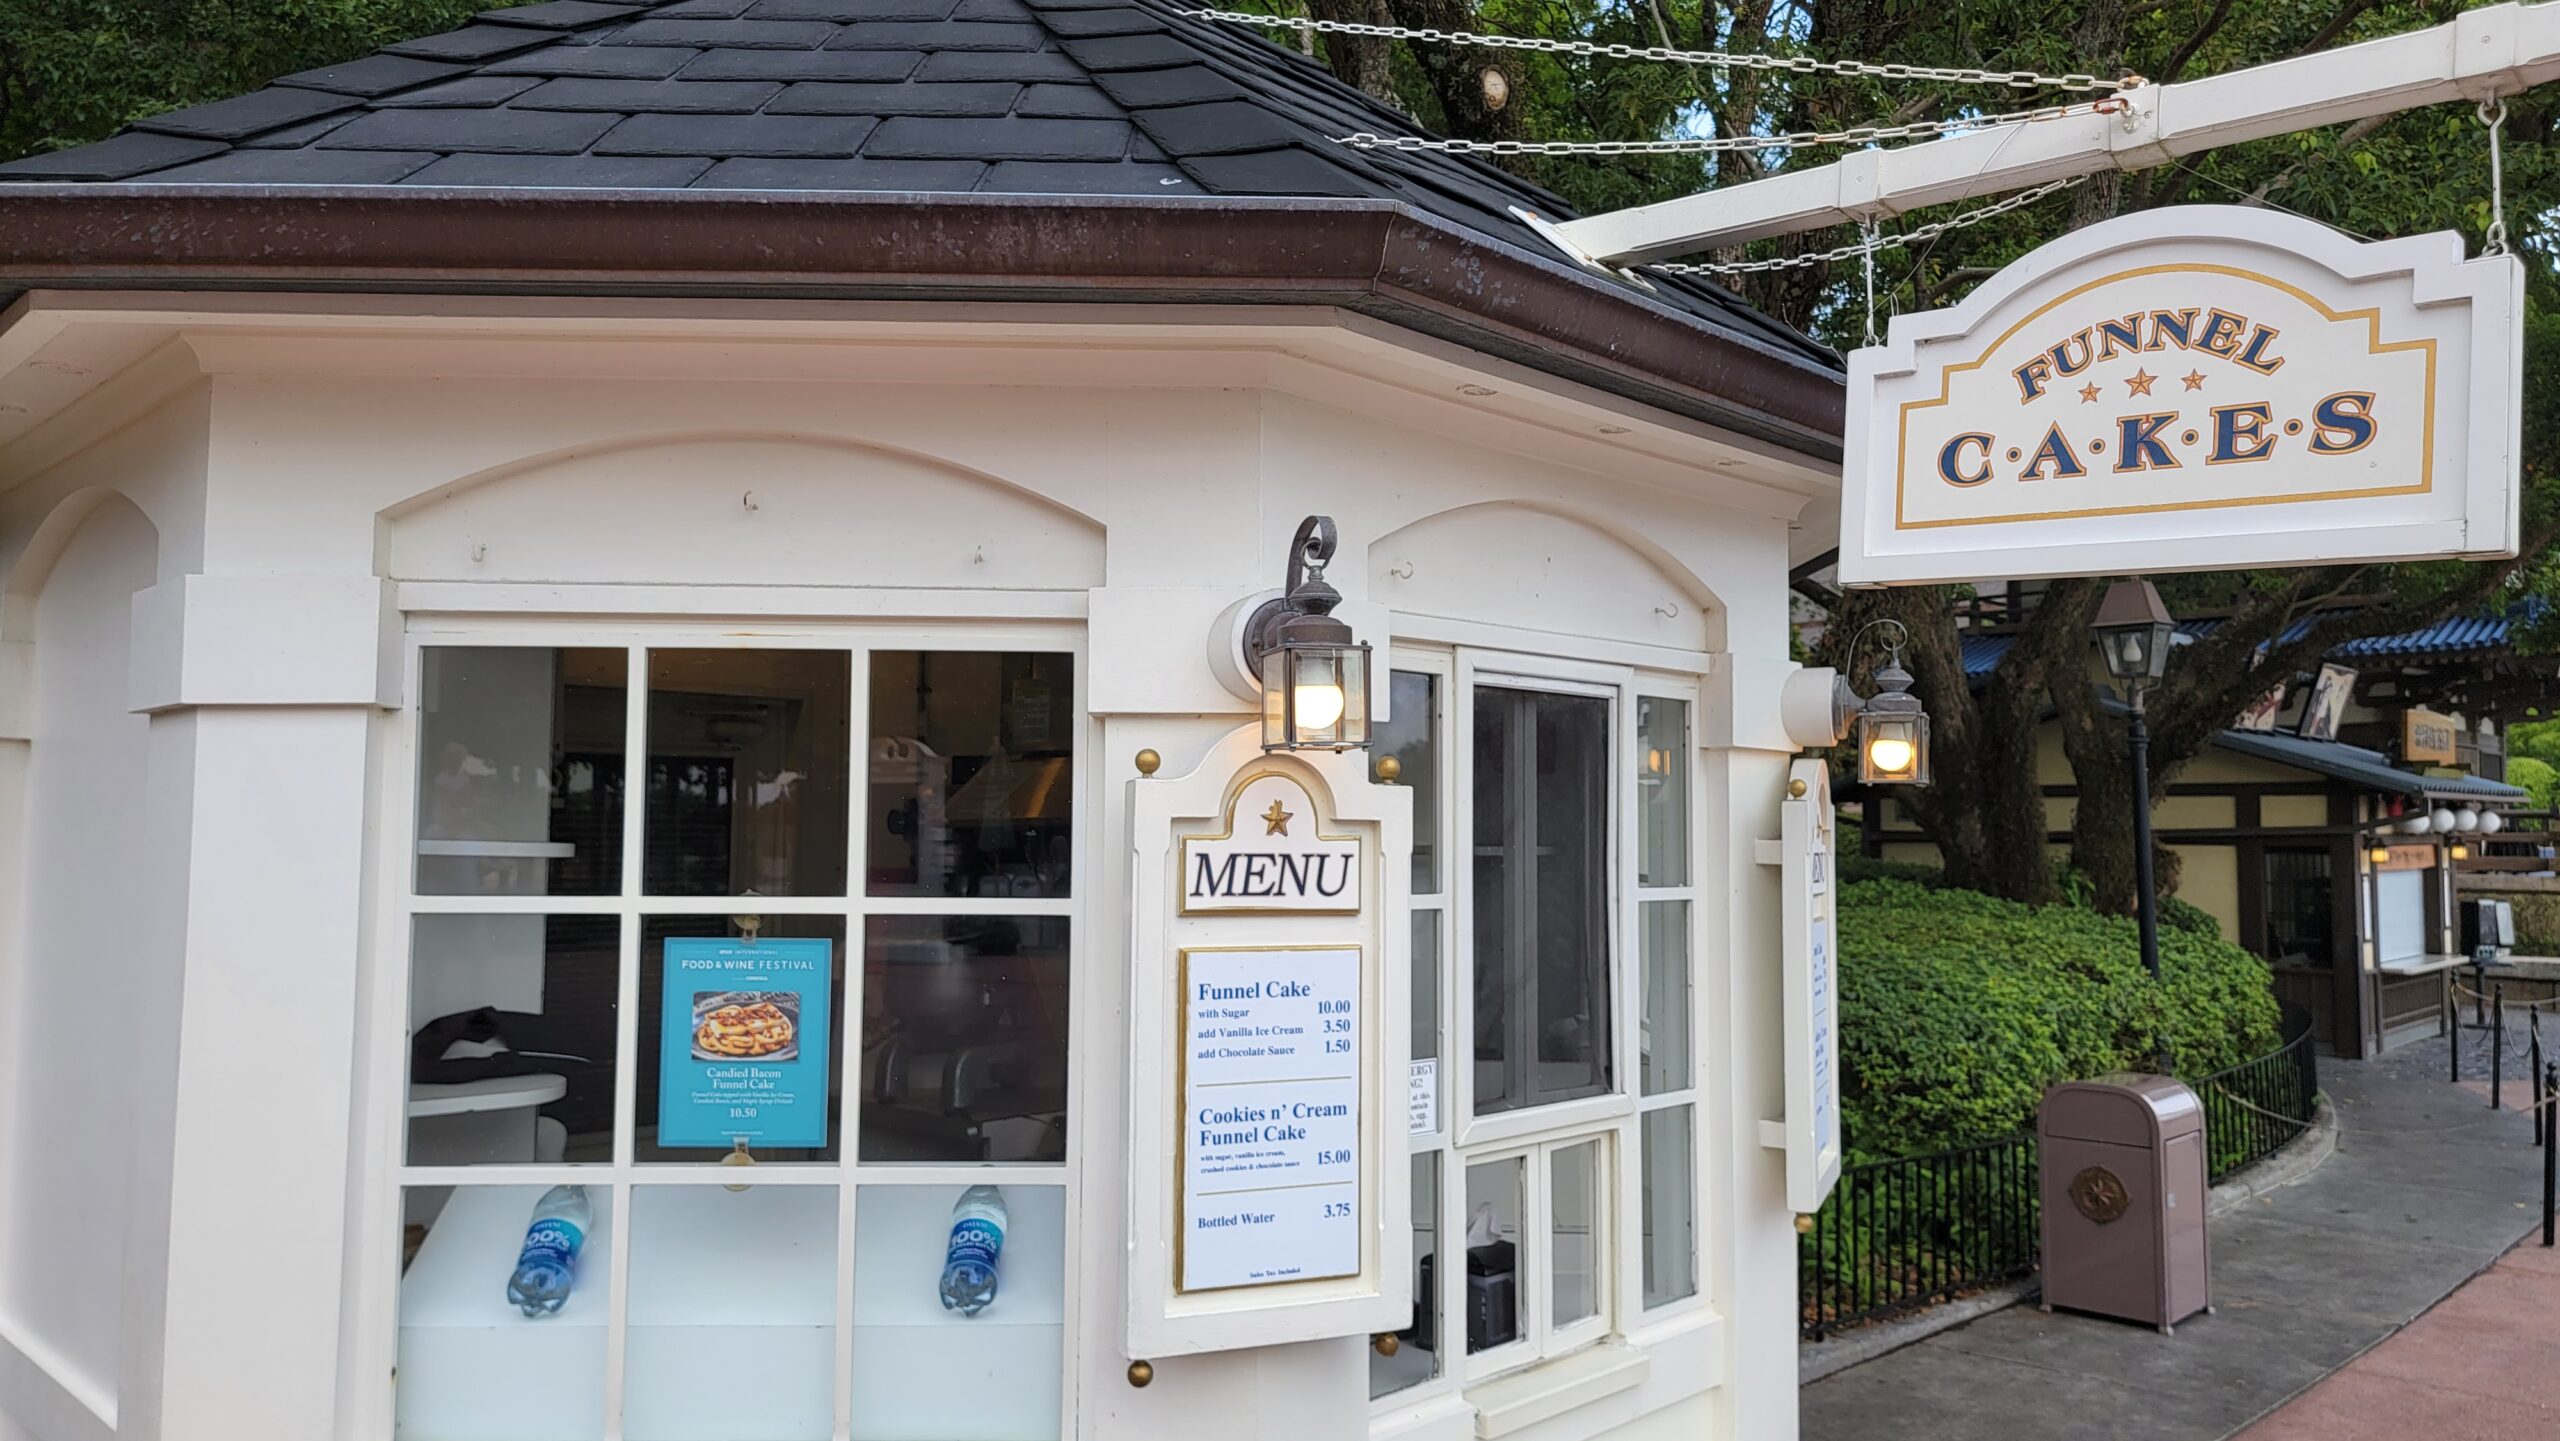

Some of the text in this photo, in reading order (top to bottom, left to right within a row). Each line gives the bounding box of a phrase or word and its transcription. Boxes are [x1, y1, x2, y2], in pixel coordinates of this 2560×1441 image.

[2012, 307, 2285, 406] FUNNEL
[1189, 853, 1354, 897] MENU
[682, 960, 815, 970] FOOD & WINE FESTIVAL
[1198, 981, 1311, 1001] Funnel Cake
[1198, 1008, 1250, 1020] with Sugar
[1318, 1000, 1350, 1015] 10.00
[1198, 1025, 1304, 1039] add Vanilla Ice Cream
[1323, 1019, 1350, 1033] 3.50
[1198, 1045, 1295, 1059] add Chocolate Sauce
[1325, 1039, 1350, 1054] 1.50
[707, 1067, 782, 1078] Candied Bacon
[713, 1079, 776, 1089] Funnel Cake
[730, 1107, 757, 1118] 10.50
[1200, 1106, 1265, 1125] Cookies
[1293, 1102, 1347, 1118] Cream
[1200, 1125, 1306, 1146] Funnel Cake
[1318, 1150, 1350, 1165] 15.00
[1324, 1203, 1350, 1218] 3.75
[1198, 1213, 1275, 1229] Bottled Water
